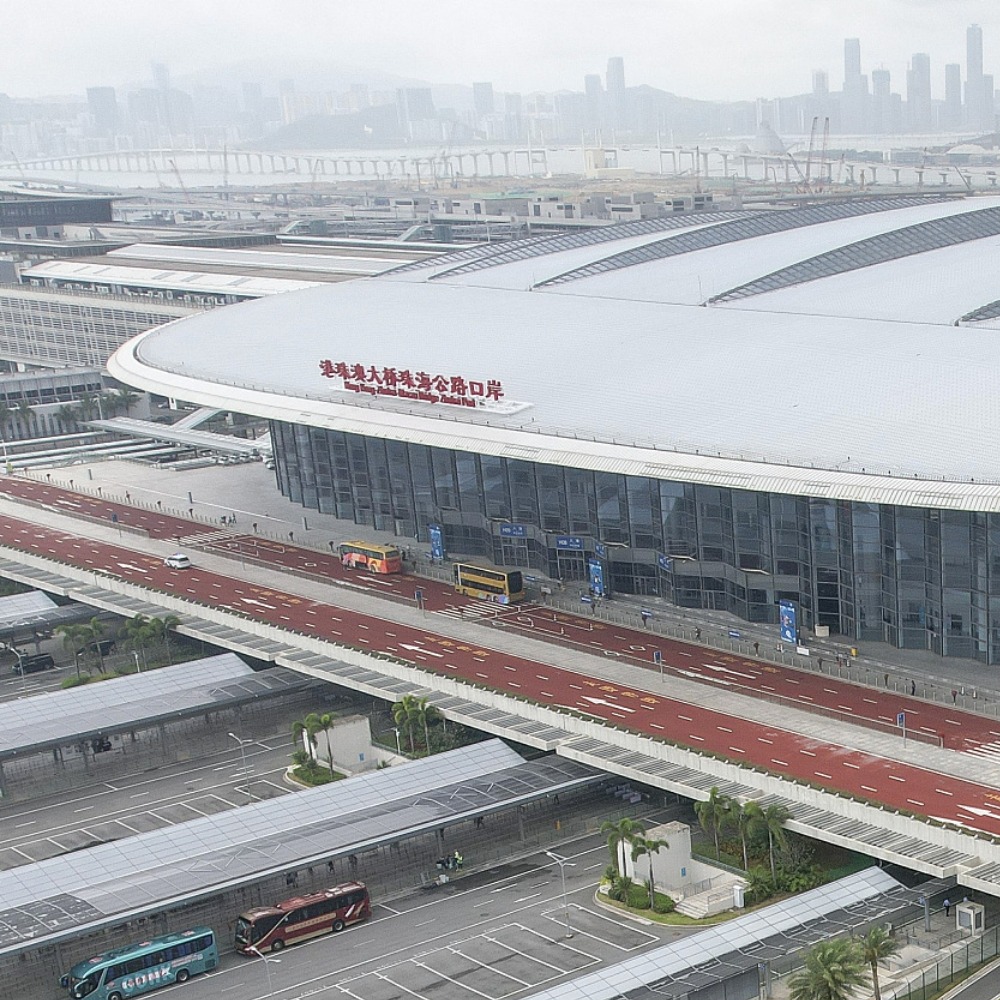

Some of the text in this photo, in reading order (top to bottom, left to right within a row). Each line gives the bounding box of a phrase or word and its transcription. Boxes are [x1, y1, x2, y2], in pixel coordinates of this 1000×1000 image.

[319, 359, 504, 401] 港珠澳大桥珠海公路口岸
